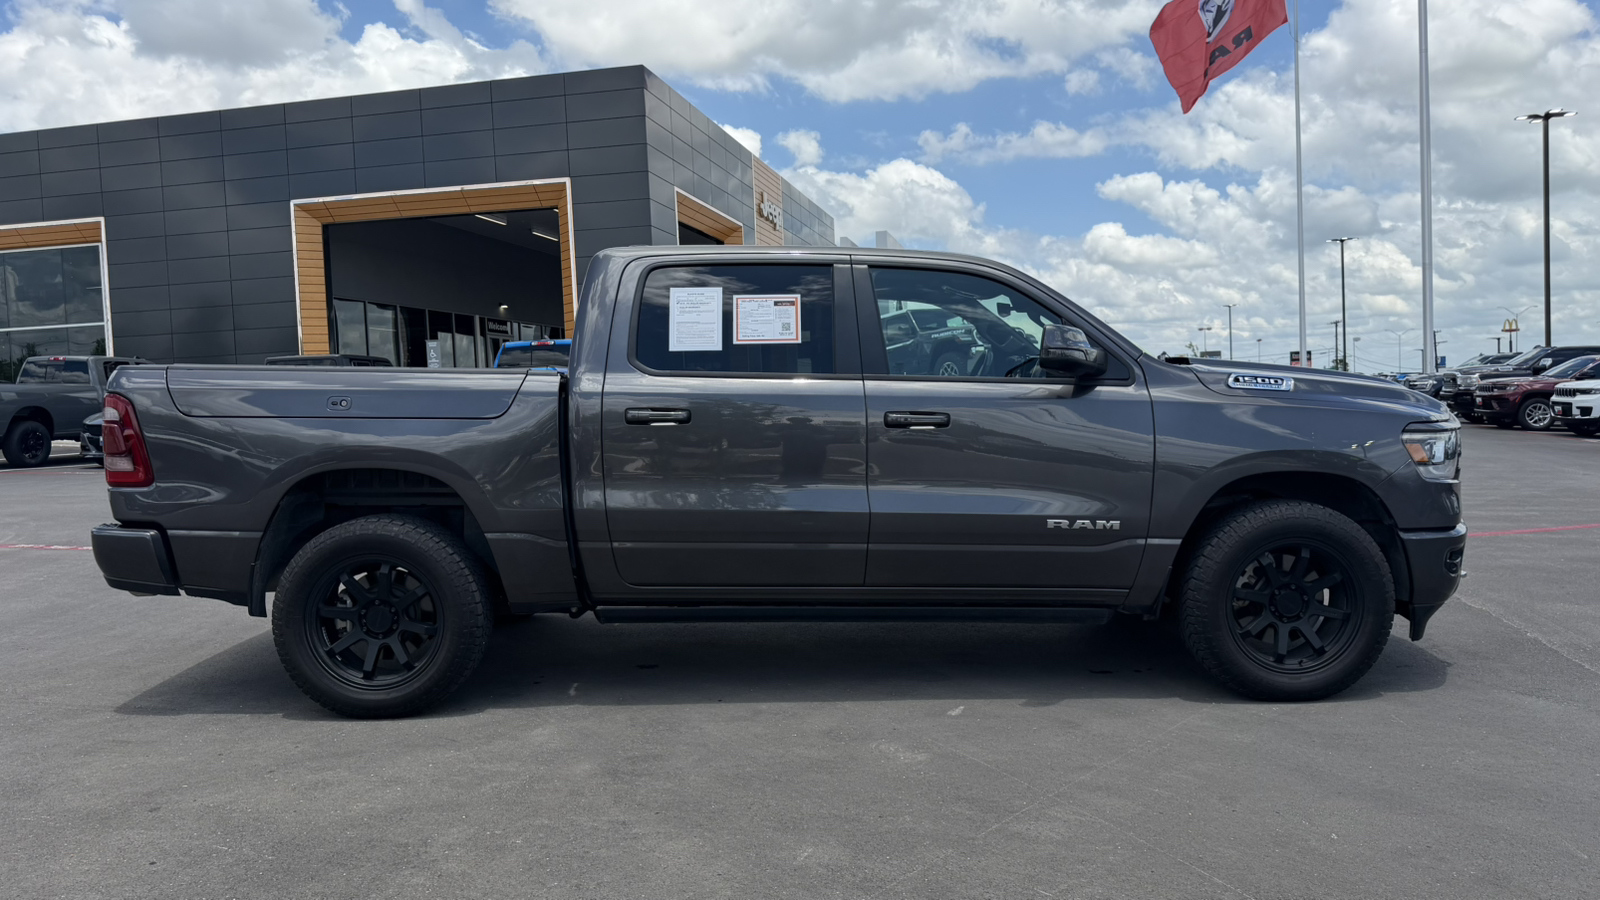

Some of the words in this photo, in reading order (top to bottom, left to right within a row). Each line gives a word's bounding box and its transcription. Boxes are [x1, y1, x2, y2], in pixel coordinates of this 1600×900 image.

[759, 191, 782, 230] Jeep
[1236, 376, 1283, 385] 1500
[1047, 519, 1121, 530] RAM
